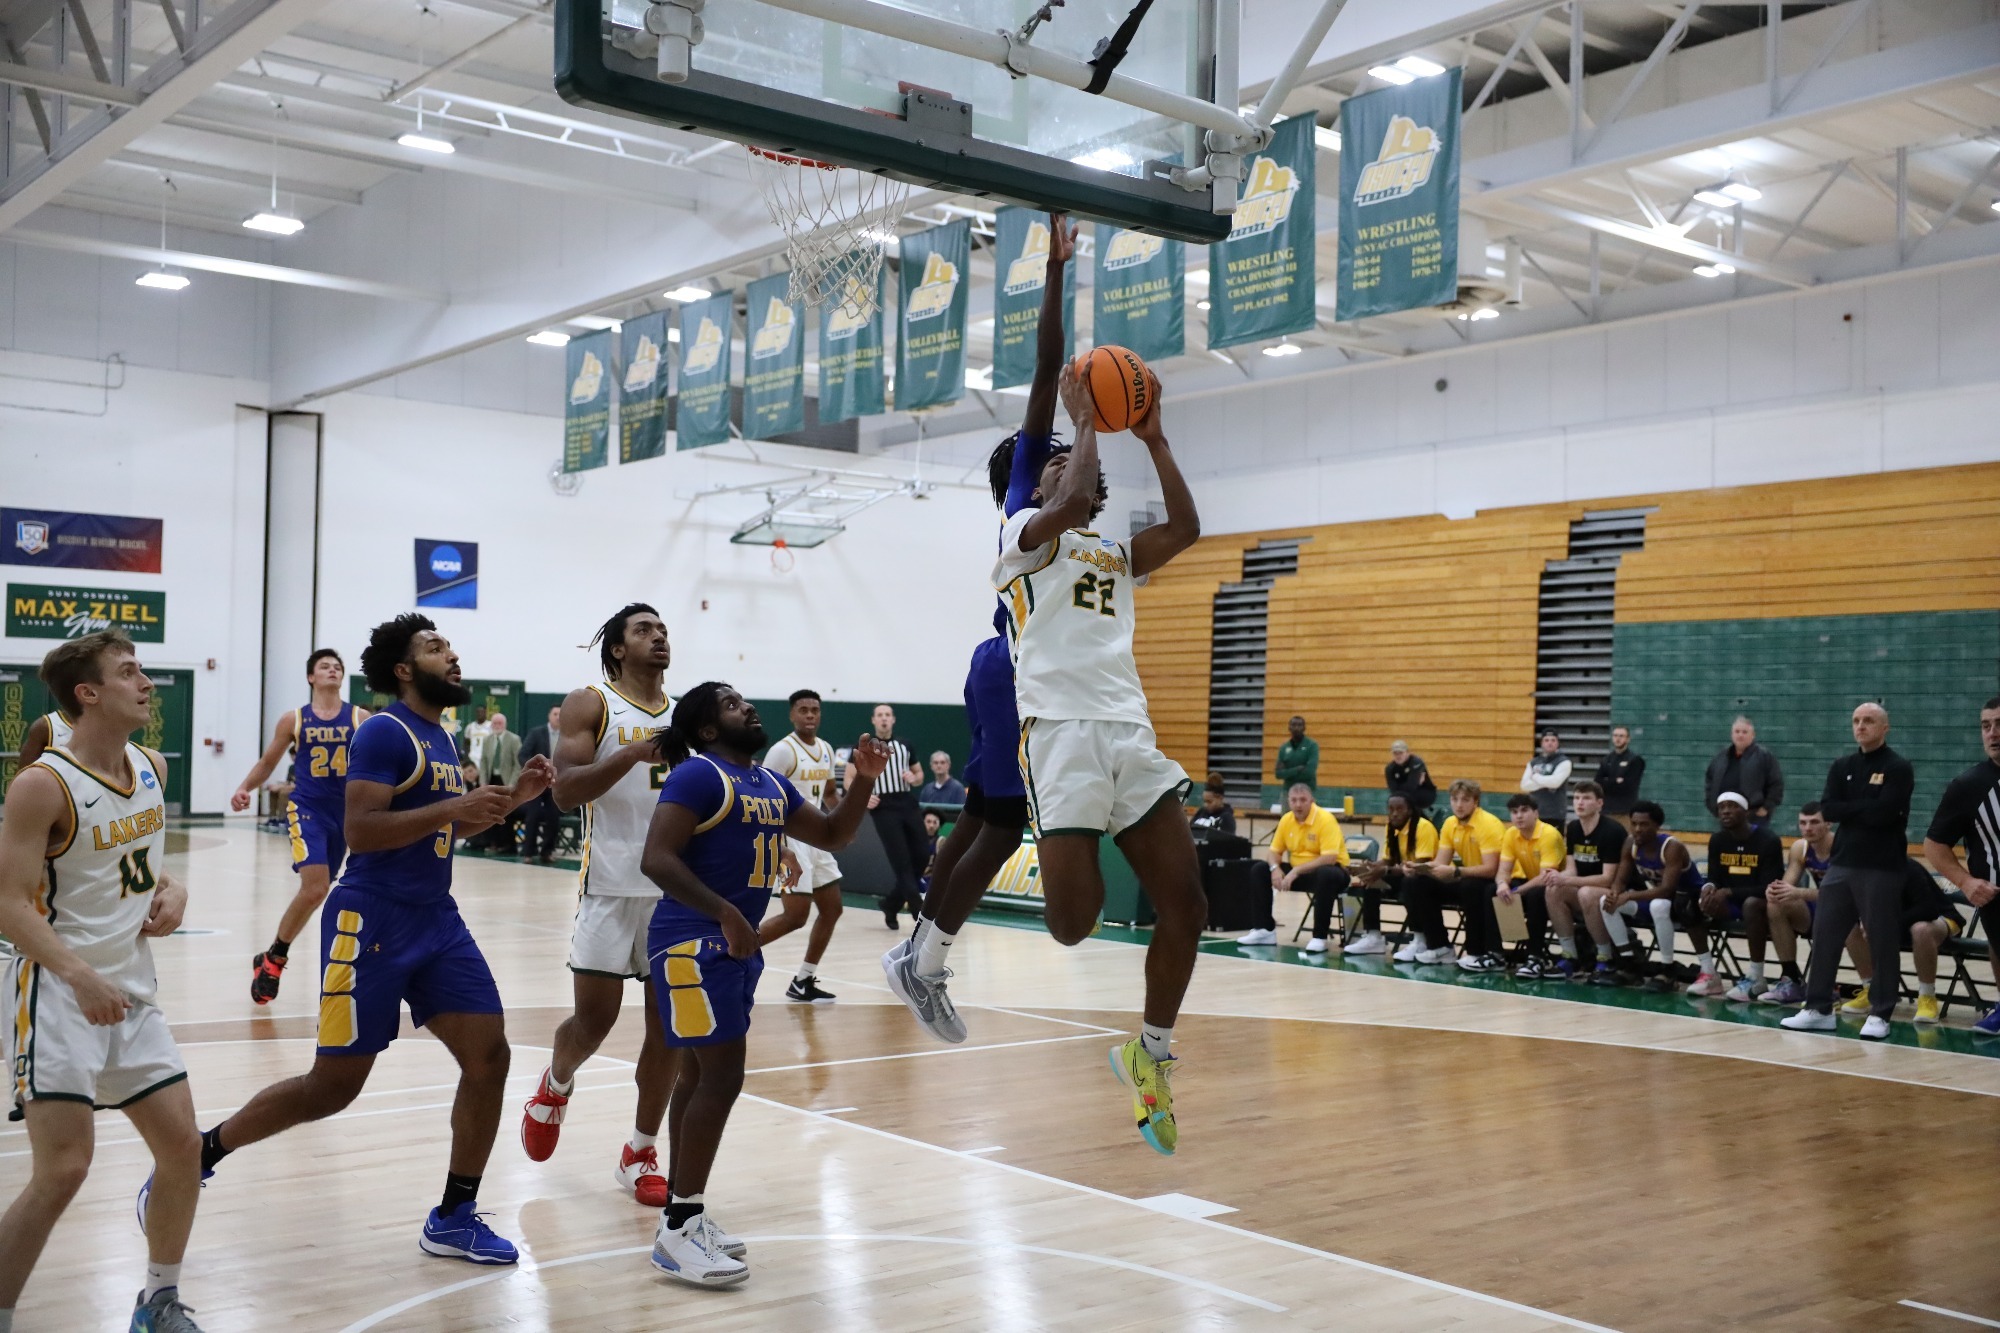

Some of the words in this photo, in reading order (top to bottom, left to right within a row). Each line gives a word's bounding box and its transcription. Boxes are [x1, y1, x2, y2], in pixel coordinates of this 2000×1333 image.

[1358, 212, 1436, 240] WRESTLING
[1390, 229, 1440, 248] CHAMPION
[1227, 247, 1294, 273] WRESTLING
[1249, 265, 1285, 282] DIVISION
[1103, 277, 1171, 301] VOLLEYBALL
[1228, 276, 1294, 299] CHAMPIONSHIPS
[1124, 353, 1146, 413] Wilson
[48, 590, 77, 599] SUNY
[82, 591, 129, 601] OSWEGO
[1072, 570, 1116, 618] 22
[15, 598, 78, 618] MAX
[89, 601, 158, 623] ZIEL
[63, 611, 111, 638] Gym
[305, 725, 349, 743] POLY
[310, 746, 347, 778] 24
[740, 795, 785, 826] POLY
[93, 804, 164, 851] LAKERS
[119, 846, 156, 900] 10
[748, 832, 779, 888] 11
